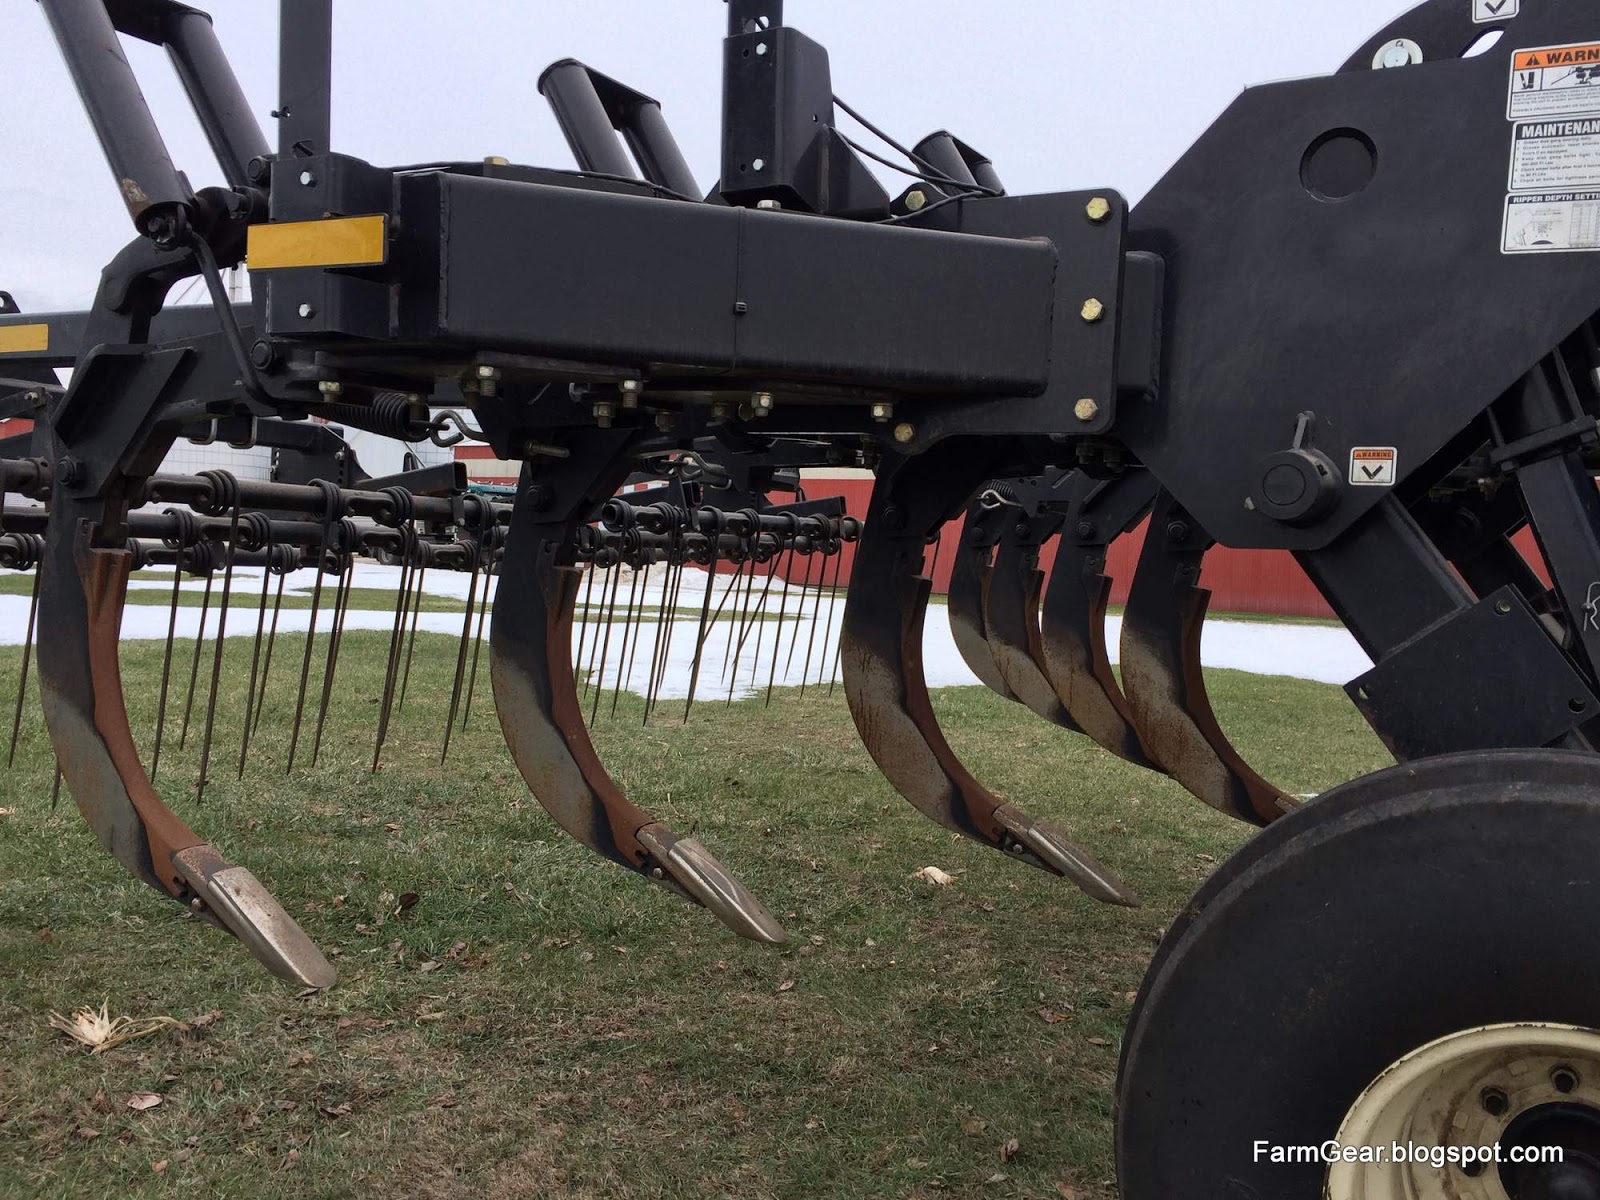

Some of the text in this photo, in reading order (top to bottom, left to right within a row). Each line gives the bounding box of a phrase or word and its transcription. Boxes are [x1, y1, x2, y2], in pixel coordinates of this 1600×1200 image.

[1546, 48, 1600, 64] WARN
[1522, 120, 1600, 138] MAINTENAN
[1513, 192, 1600, 203] RIPPER DEPTH SETTI
